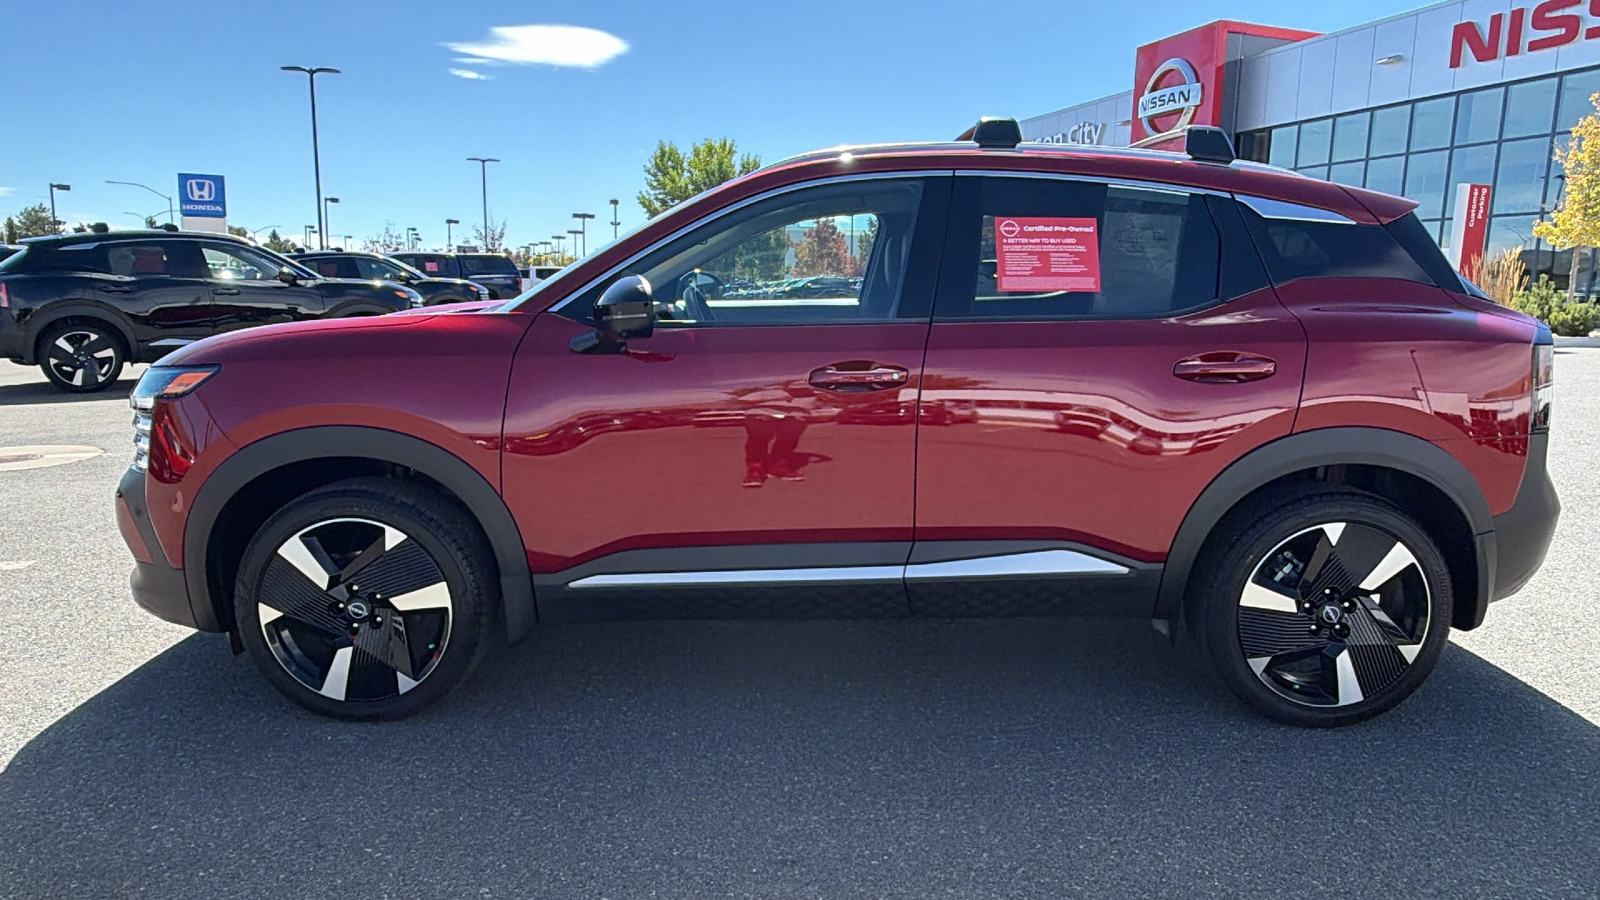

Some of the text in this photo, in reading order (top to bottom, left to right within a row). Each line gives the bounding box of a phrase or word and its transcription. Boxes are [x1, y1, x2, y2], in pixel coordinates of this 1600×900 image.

[1449, 0, 1600, 68] NIS
[1140, 88, 1191, 112] NISSAN
[1067, 121, 1103, 145] City
[1468, 187, 1480, 228] Customer
[1477, 187, 1487, 219] Parking
